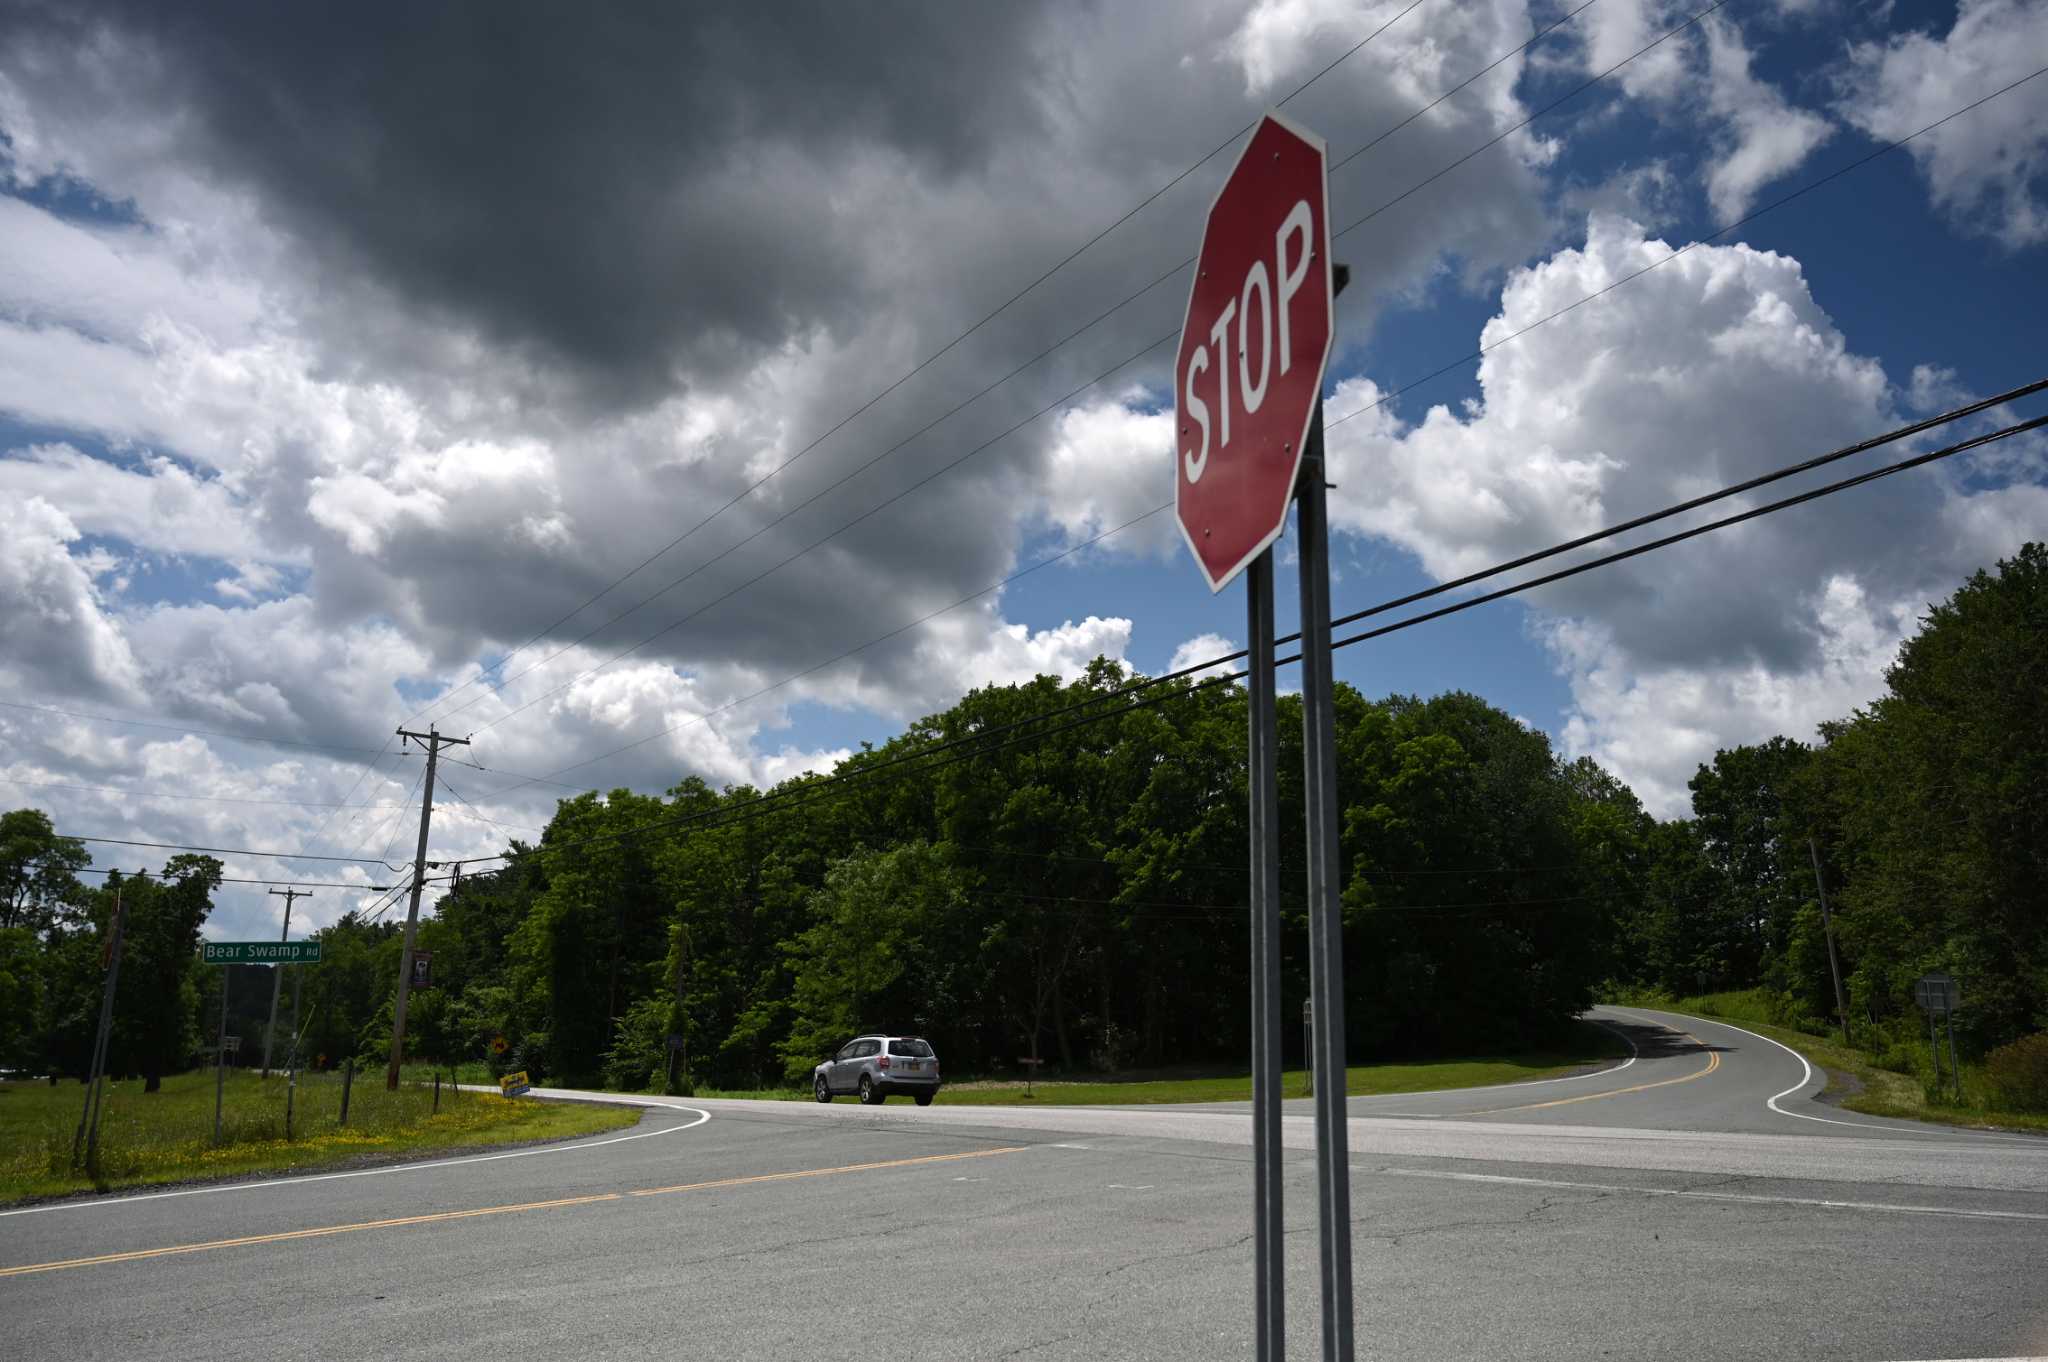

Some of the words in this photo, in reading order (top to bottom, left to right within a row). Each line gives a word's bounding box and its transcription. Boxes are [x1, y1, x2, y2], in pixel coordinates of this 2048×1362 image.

[1185, 200, 1313, 484] STOP
[206, 945, 241, 958] Bear
[247, 944, 300, 959] Swamp
[306, 947, 319, 957] Rd
